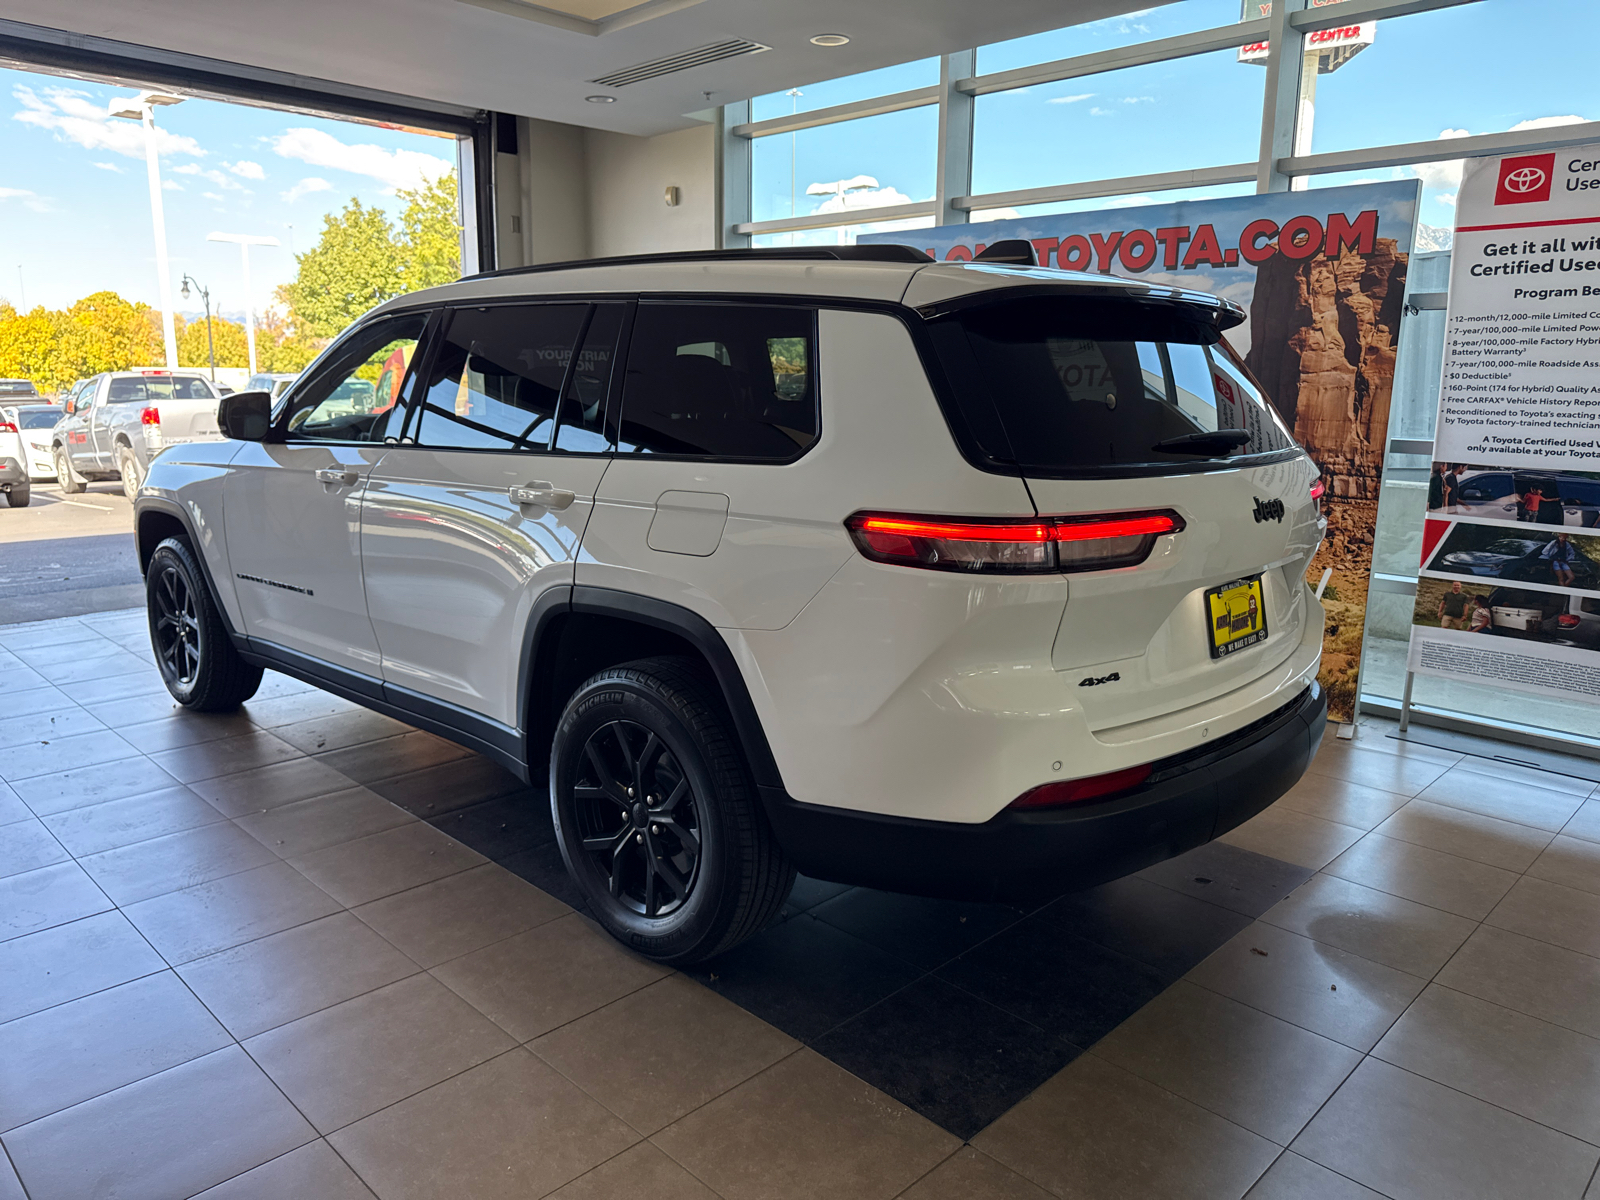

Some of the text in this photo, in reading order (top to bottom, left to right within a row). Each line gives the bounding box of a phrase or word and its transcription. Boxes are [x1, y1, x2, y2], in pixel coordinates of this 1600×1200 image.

[1310, 26, 1361, 43] CENTER
[1483, 242, 1518, 257] Get
[1522, 240, 1536, 255] it
[1540, 238, 1566, 253] all
[1470, 259, 1554, 277] Certified
[1514, 289, 1578, 300] Program
[1455, 312, 1551, 323] 12-month/12,000-mile
[1553, 311, 1587, 319] Limited
[1454, 325, 1541, 336] 7-year/100,000-mile
[1580, 324, 1600, 332] Pow
[1452, 338, 1539, 347] 8-year/100,000-mile
[1541, 337, 1574, 346] Factory
[1451, 349, 1482, 357] Battery
[1451, 360, 1600, 369] 7-year/100,000-mile Roadside Ass
[1056, 364, 1116, 387] OTA
[1489, 385, 1506, 393] (174
[1522, 385, 1554, 394] Hybrid)
[1556, 386, 1589, 395] Quality
[1506, 397, 1537, 405] Vehicle
[1539, 398, 1572, 407] History
[1446, 408, 1507, 416] Reconditioned
[1556, 411, 1596, 421] exacting
[1445, 417, 1455, 425] by
[1457, 417, 1484, 426] Toyota
[1486, 418, 1551, 428] factory-trained
[1482, 435, 1490, 443] A
[1492, 436, 1522, 445] Toyota
[1524, 437, 1567, 447] Certified
[1569, 439, 1594, 448] Used
[1467, 445, 1487, 453] only
[1488, 446, 1531, 455] available
[1544, 449, 1567, 457] your
[1253, 496, 1285, 523] Jeep
[1078, 671, 1121, 687] 4x4
[578, 692, 623, 715] MICHELIN
